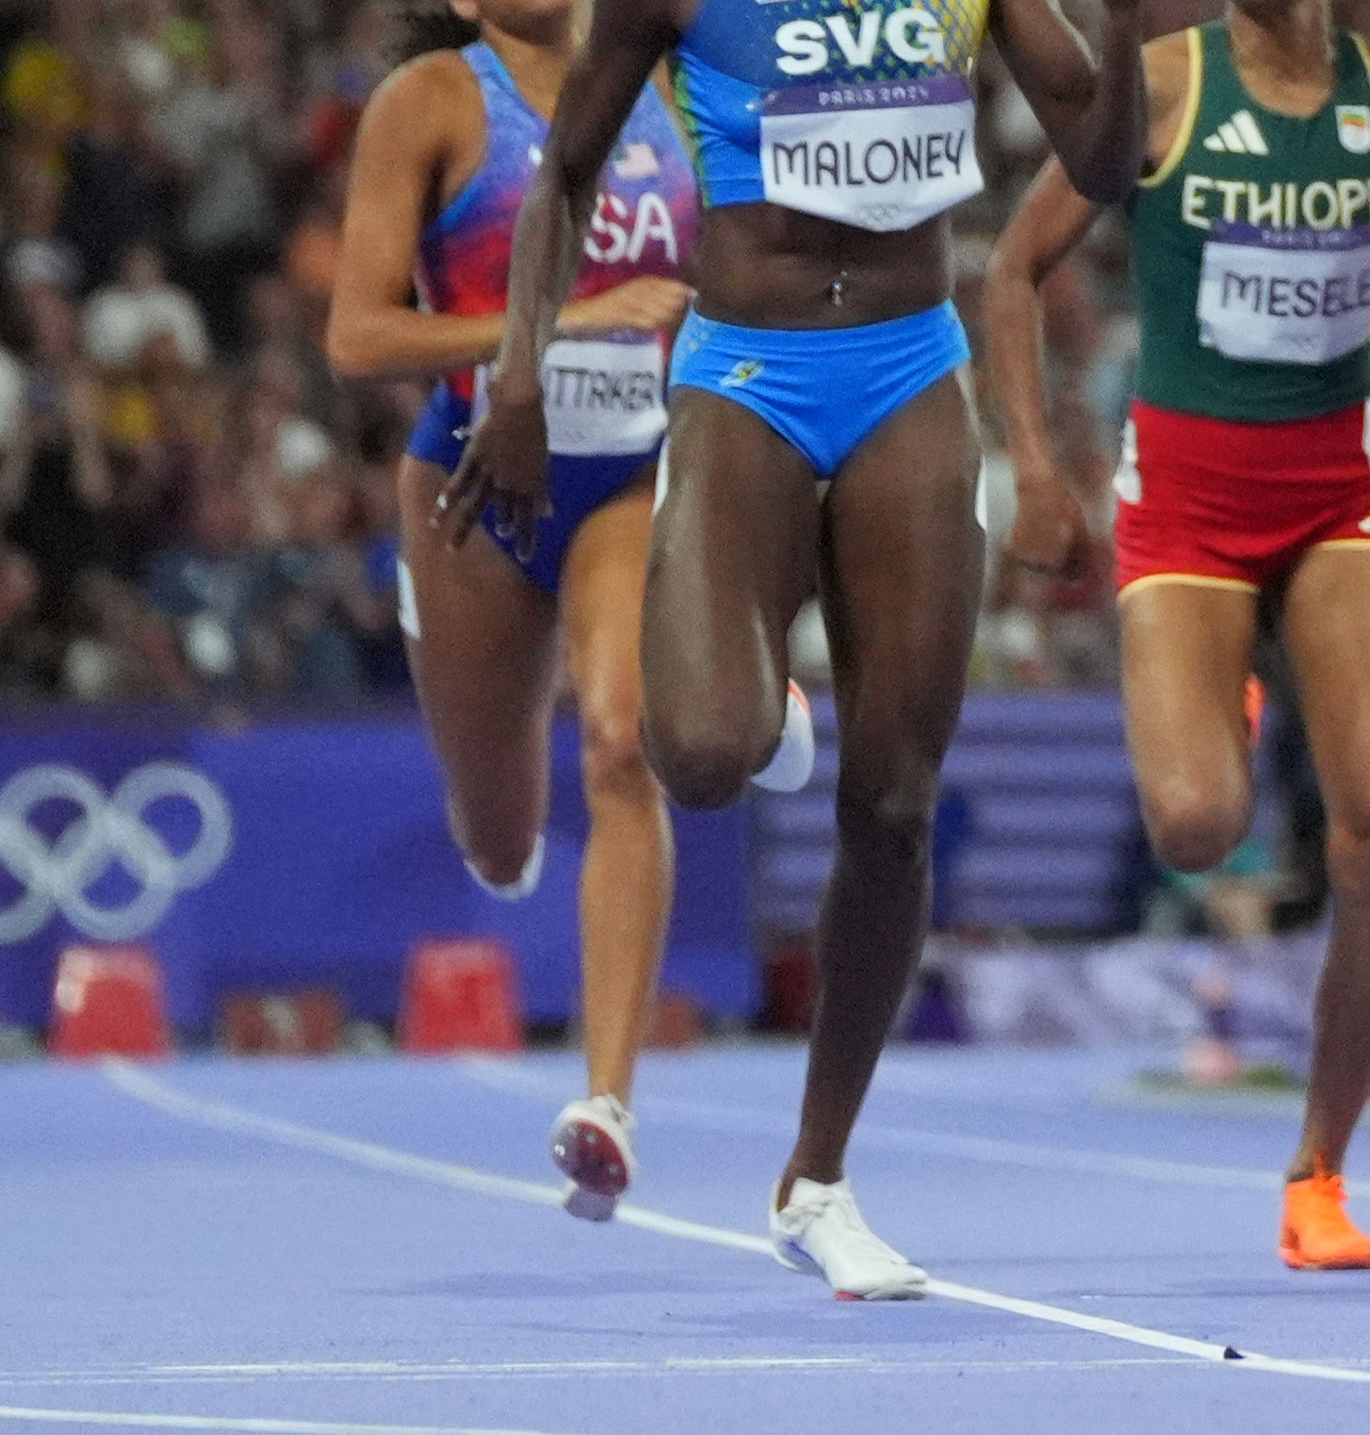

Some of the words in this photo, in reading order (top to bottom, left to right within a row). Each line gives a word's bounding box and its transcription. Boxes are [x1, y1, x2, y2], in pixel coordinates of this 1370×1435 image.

[775, 8, 946, 75] SVG
[818, 88, 875, 106] PARIS
[772, 130, 965, 186] MALONEY
[583, 191, 679, 265] SA
